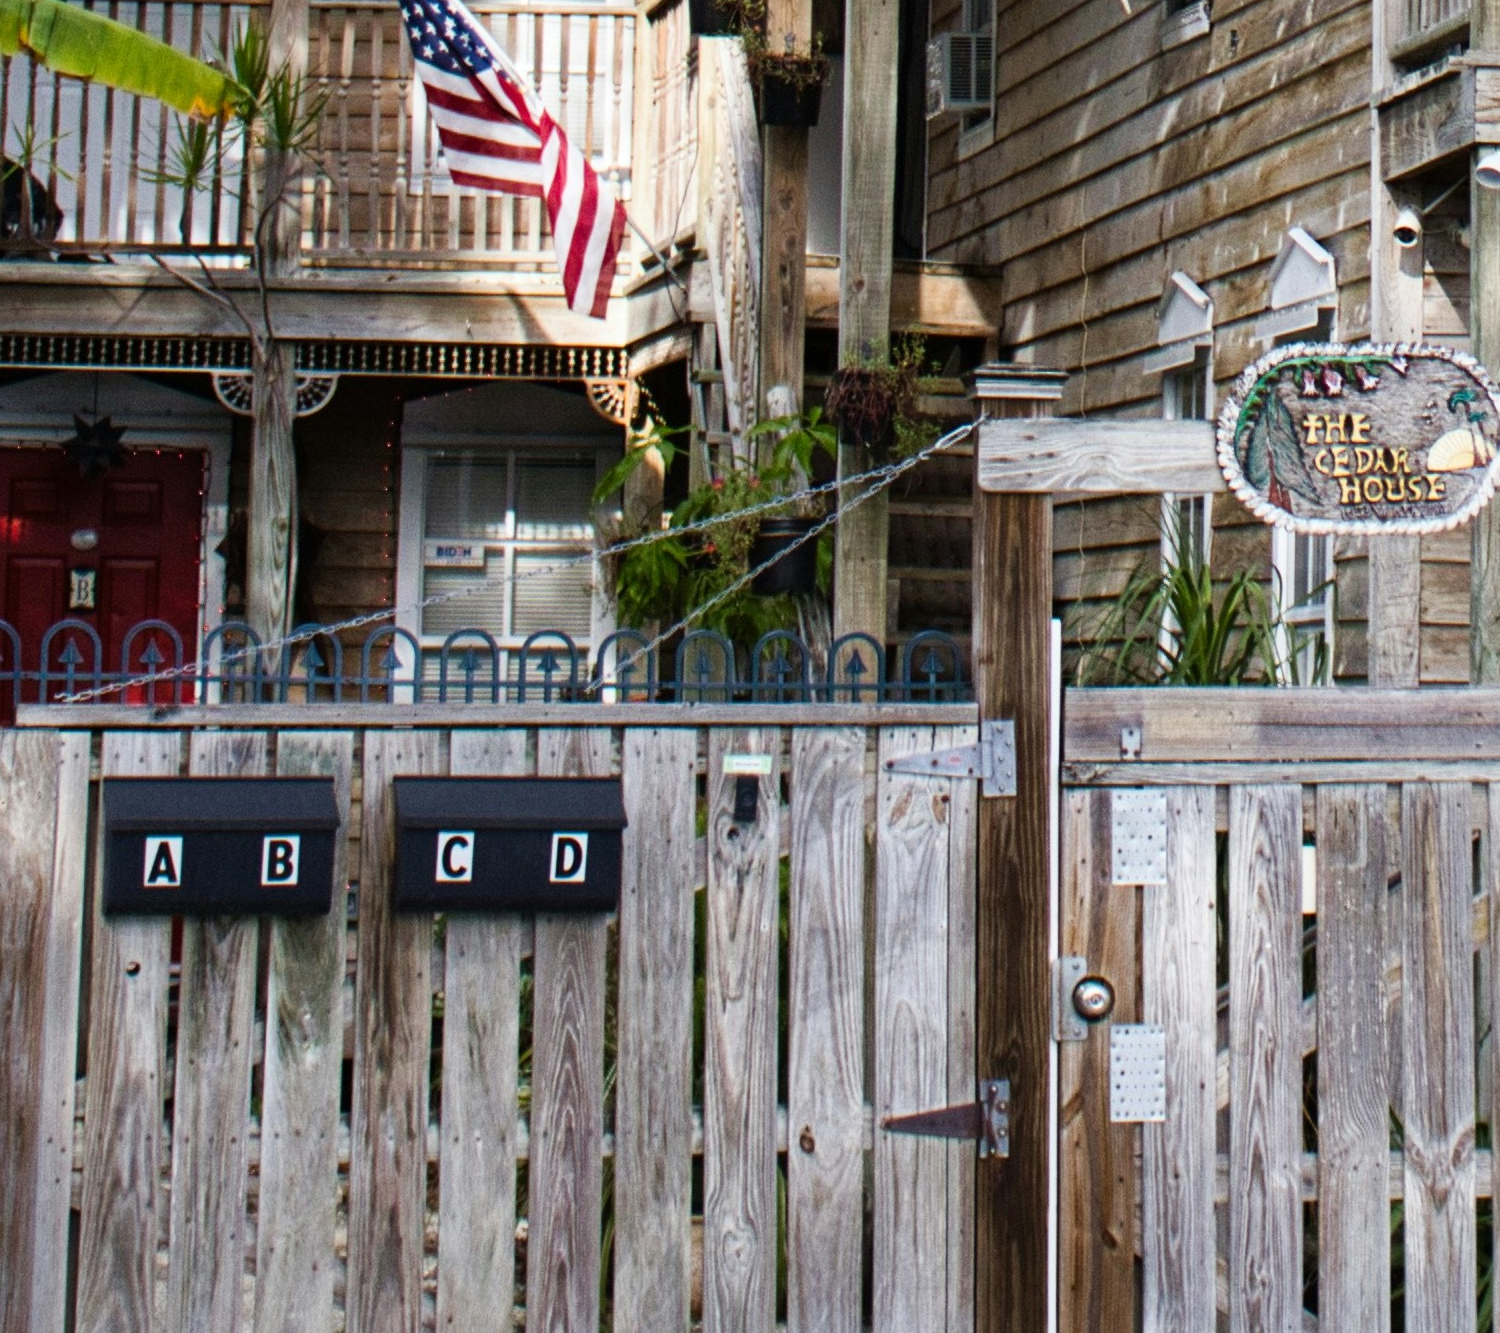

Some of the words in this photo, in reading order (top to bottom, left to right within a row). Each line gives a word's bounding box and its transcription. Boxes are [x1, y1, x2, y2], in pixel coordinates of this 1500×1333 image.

[1302, 413, 1371, 444] THE
[1314, 446, 1412, 477] CEDAR
[1338, 475, 1447, 504] HOUSE
[76, 579, 89, 601] B
[147, 840, 177, 884] A
[267, 840, 294, 882] B
[441, 835, 469, 878] C
[554, 836, 583, 879] D
